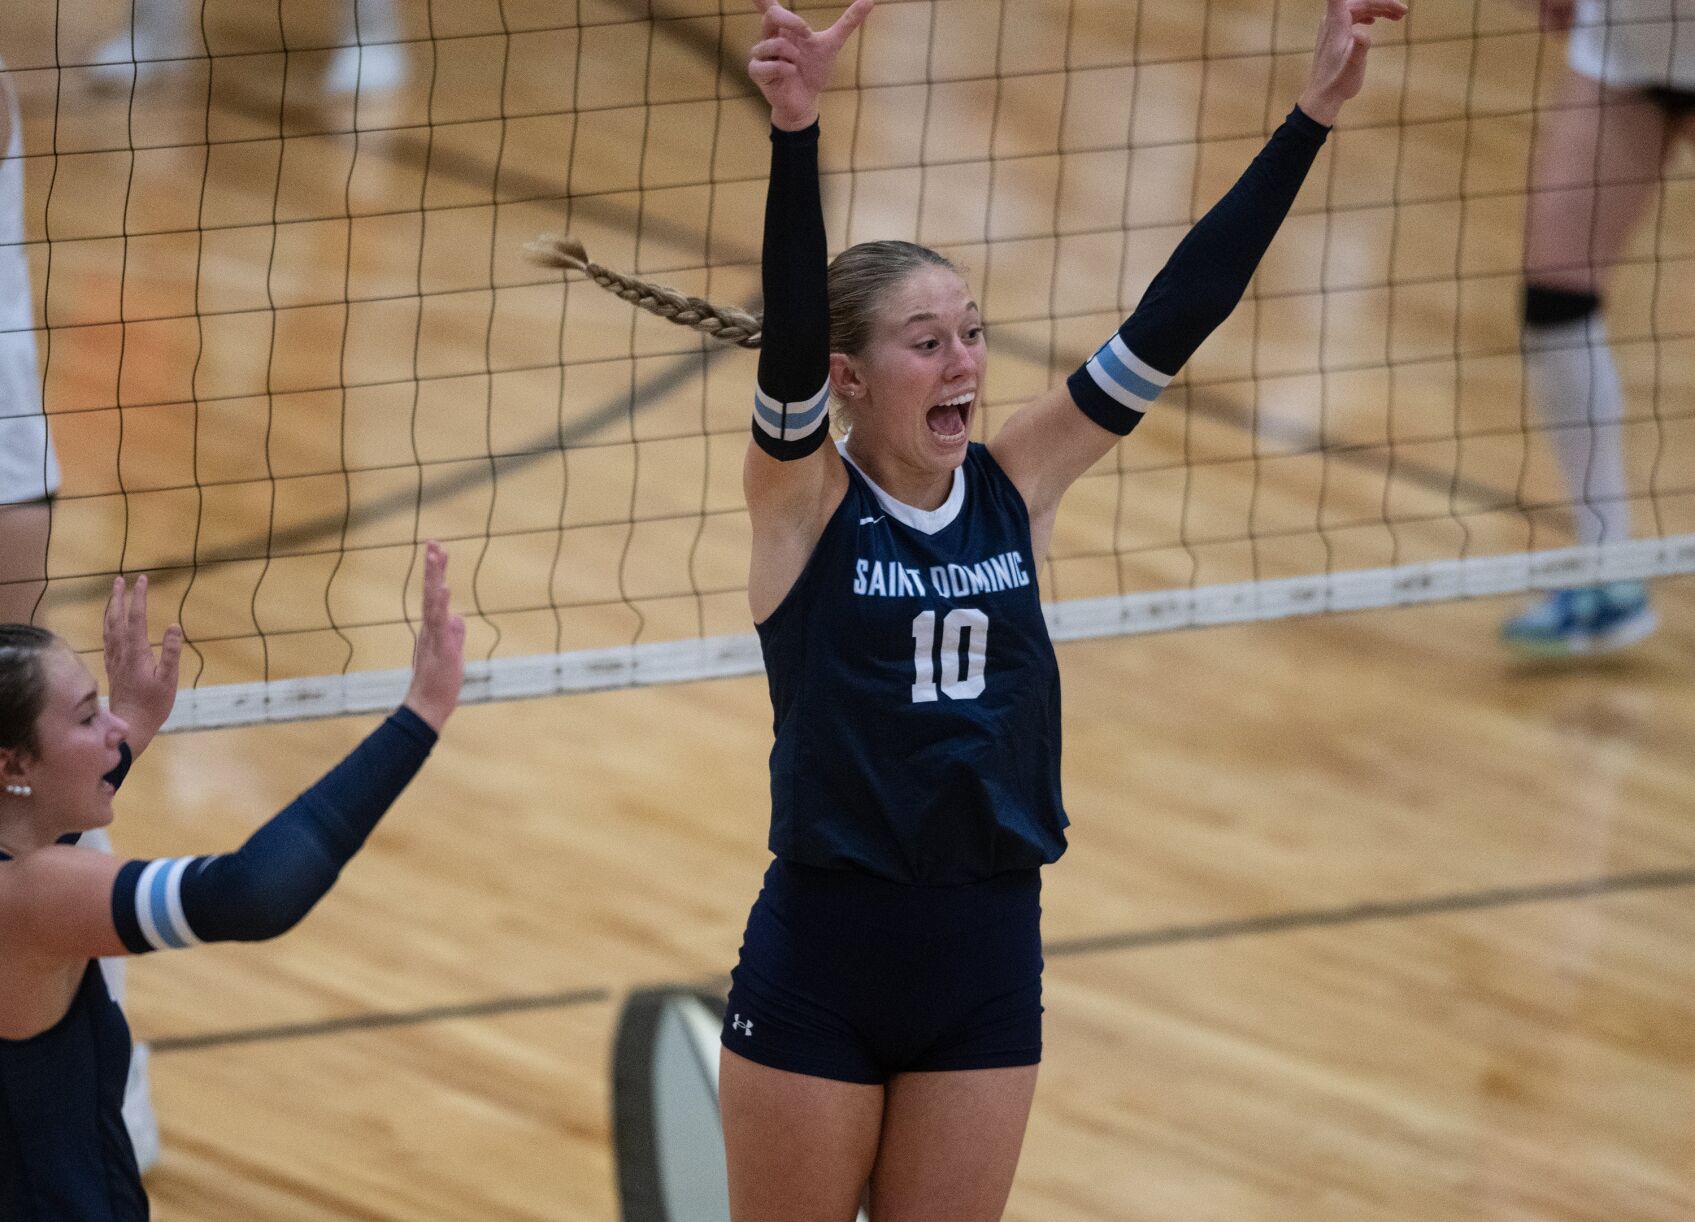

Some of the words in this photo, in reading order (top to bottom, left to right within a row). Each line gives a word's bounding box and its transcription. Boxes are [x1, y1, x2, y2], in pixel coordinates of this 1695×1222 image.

[853, 558, 926, 597] SAINT
[930, 551, 1030, 598] DOMINIC
[912, 608, 989, 703] 10
